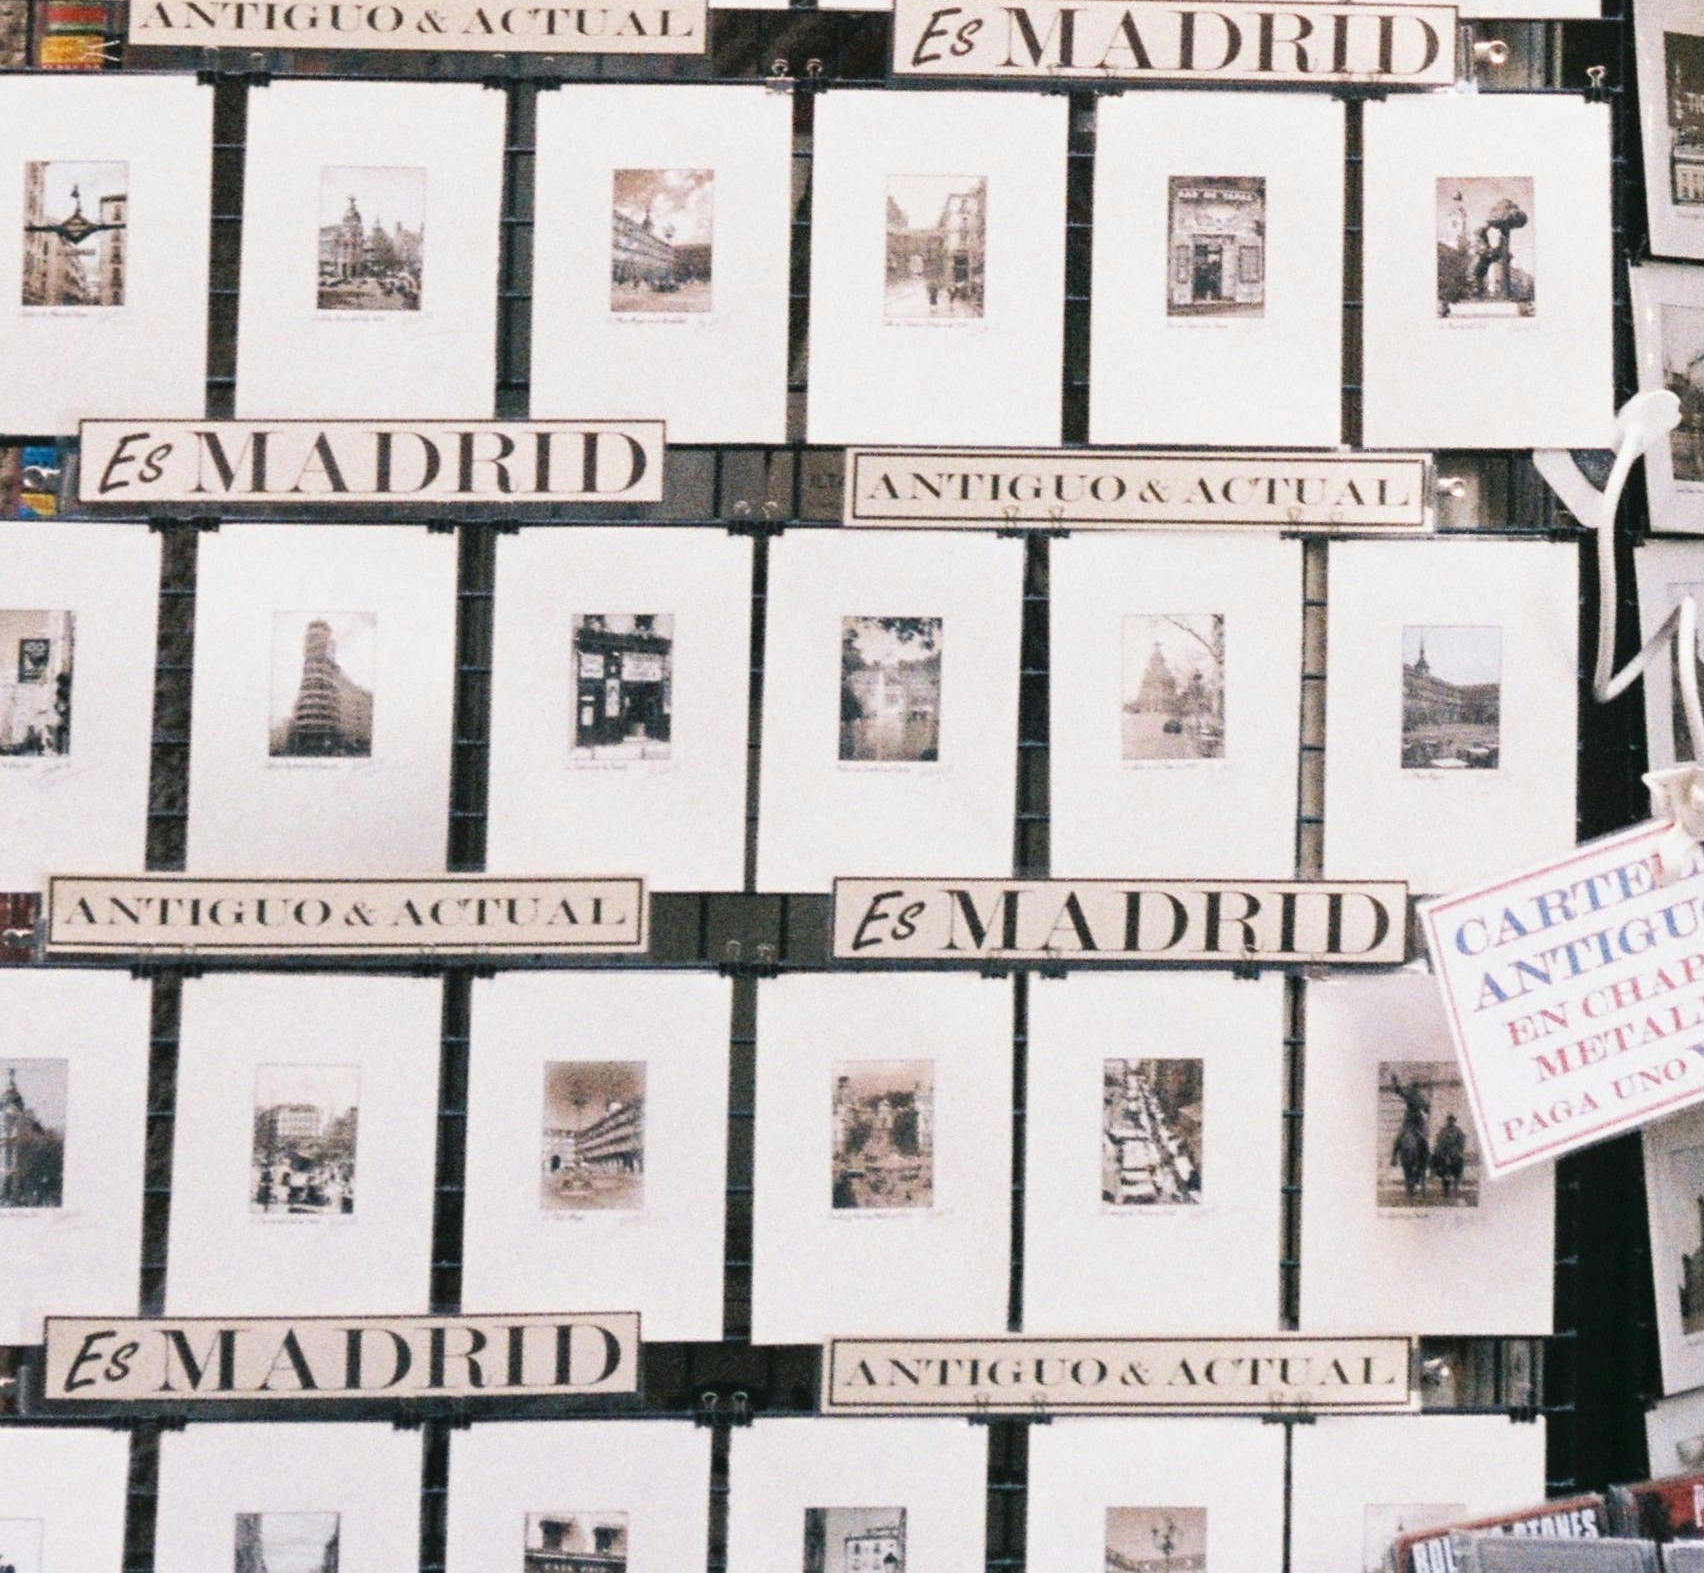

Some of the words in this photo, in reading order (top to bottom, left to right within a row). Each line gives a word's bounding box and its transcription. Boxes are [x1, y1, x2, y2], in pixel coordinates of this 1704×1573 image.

[143, 2, 403, 30] ANTIGUO
[416, 12, 443, 33] &
[464, 8, 692, 36] ACTUAL
[911, 7, 983, 66] Es
[1002, 6, 1441, 75] MADRID
[98, 432, 173, 494] Es
[190, 430, 647, 494] MADRID
[870, 473, 1126, 500] ANTIGUO
[1139, 481, 1165, 503] &
[1186, 478, 1408, 505] ACTUAL
[67, 897, 331, 926] ANTIGUO
[344, 904, 371, 926] &
[395, 898, 625, 926] ACTUAL
[852, 890, 925, 951] Es
[941, 890, 1390, 953] MADRID
[1506, 1000, 1569, 1050] EN
[1501, 1091, 1600, 1144] PAGA
[1612, 1057, 1688, 1101] UNO
[64, 1330, 139, 1392] Es
[158, 1323, 622, 1392] MADRID
[847, 1359, 1107, 1386] ANTIGUO
[1120, 1364, 1147, 1386] &
[1169, 1357, 1394, 1385] ACTUAL
